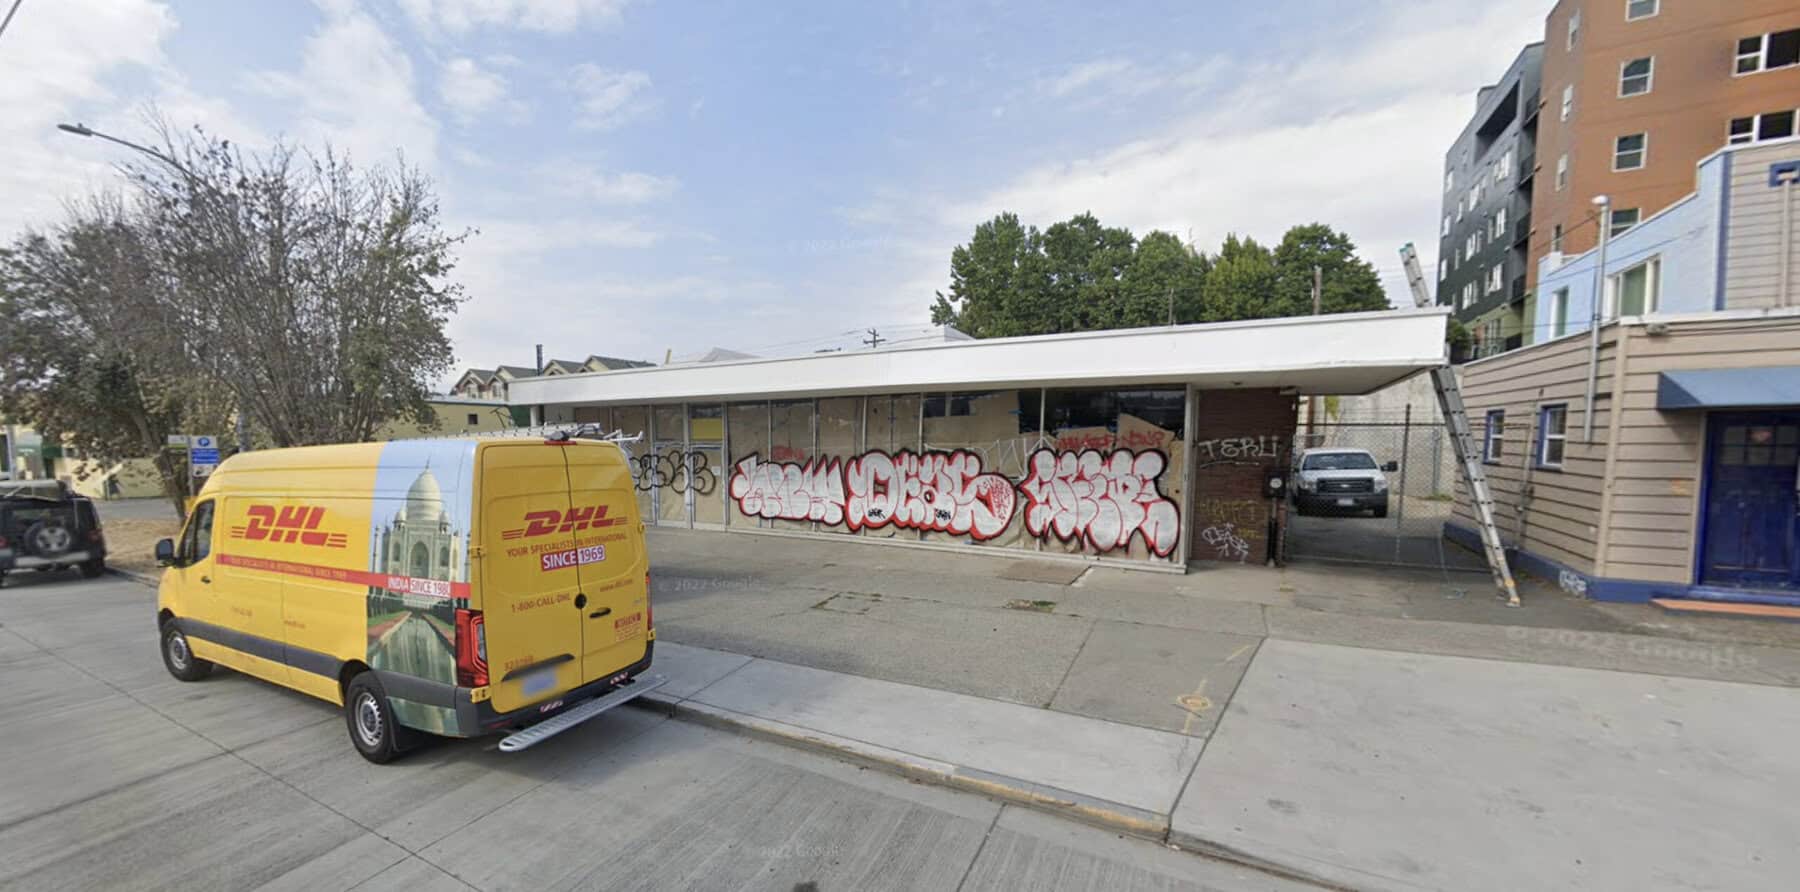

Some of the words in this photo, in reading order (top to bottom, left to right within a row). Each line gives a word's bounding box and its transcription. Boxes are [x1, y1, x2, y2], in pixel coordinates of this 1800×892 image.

[244, 504, 329, 546] DHL
[523, 504, 616, 537] DHL
[506, 546, 529, 558] YOUR
[542, 551, 577, 570] SINCE
[579, 546, 604, 564] 1969
[387, 576, 409, 591] INDIA
[411, 579, 432, 594] SINCE
